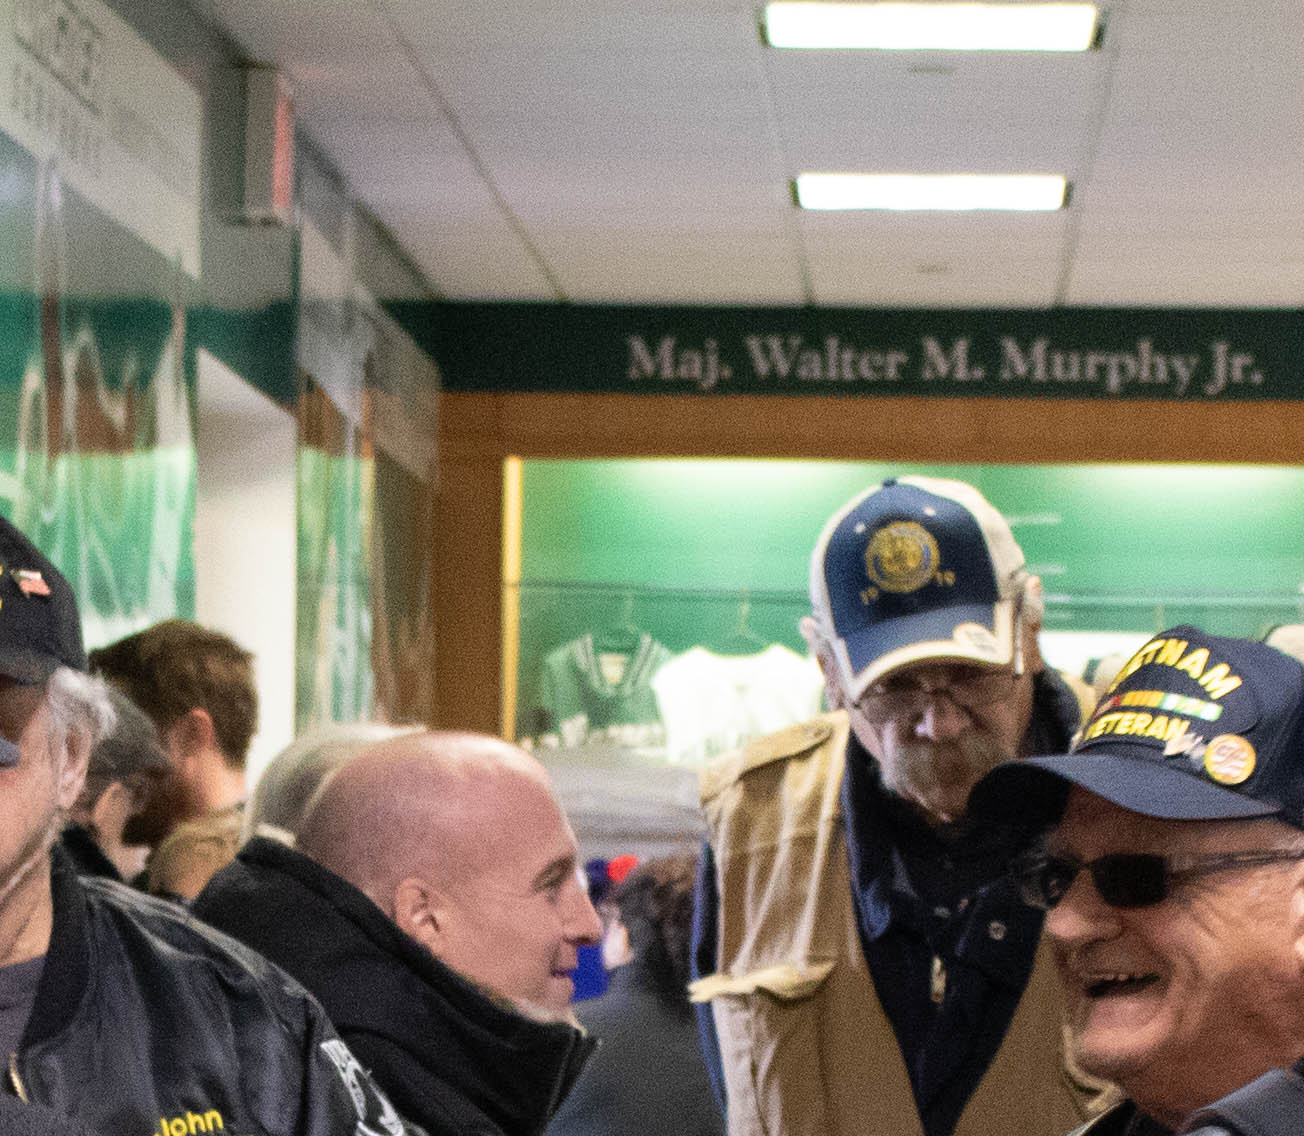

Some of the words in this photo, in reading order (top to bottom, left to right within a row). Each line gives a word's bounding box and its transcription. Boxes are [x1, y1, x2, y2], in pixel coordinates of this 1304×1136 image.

[627, 335, 732, 391] Maj.
[745, 335, 909, 382] Walter
[921, 336, 986, 382] M.
[1000, 337, 1199, 396] Murphy
[1204, 341, 1265, 396] Jr.
